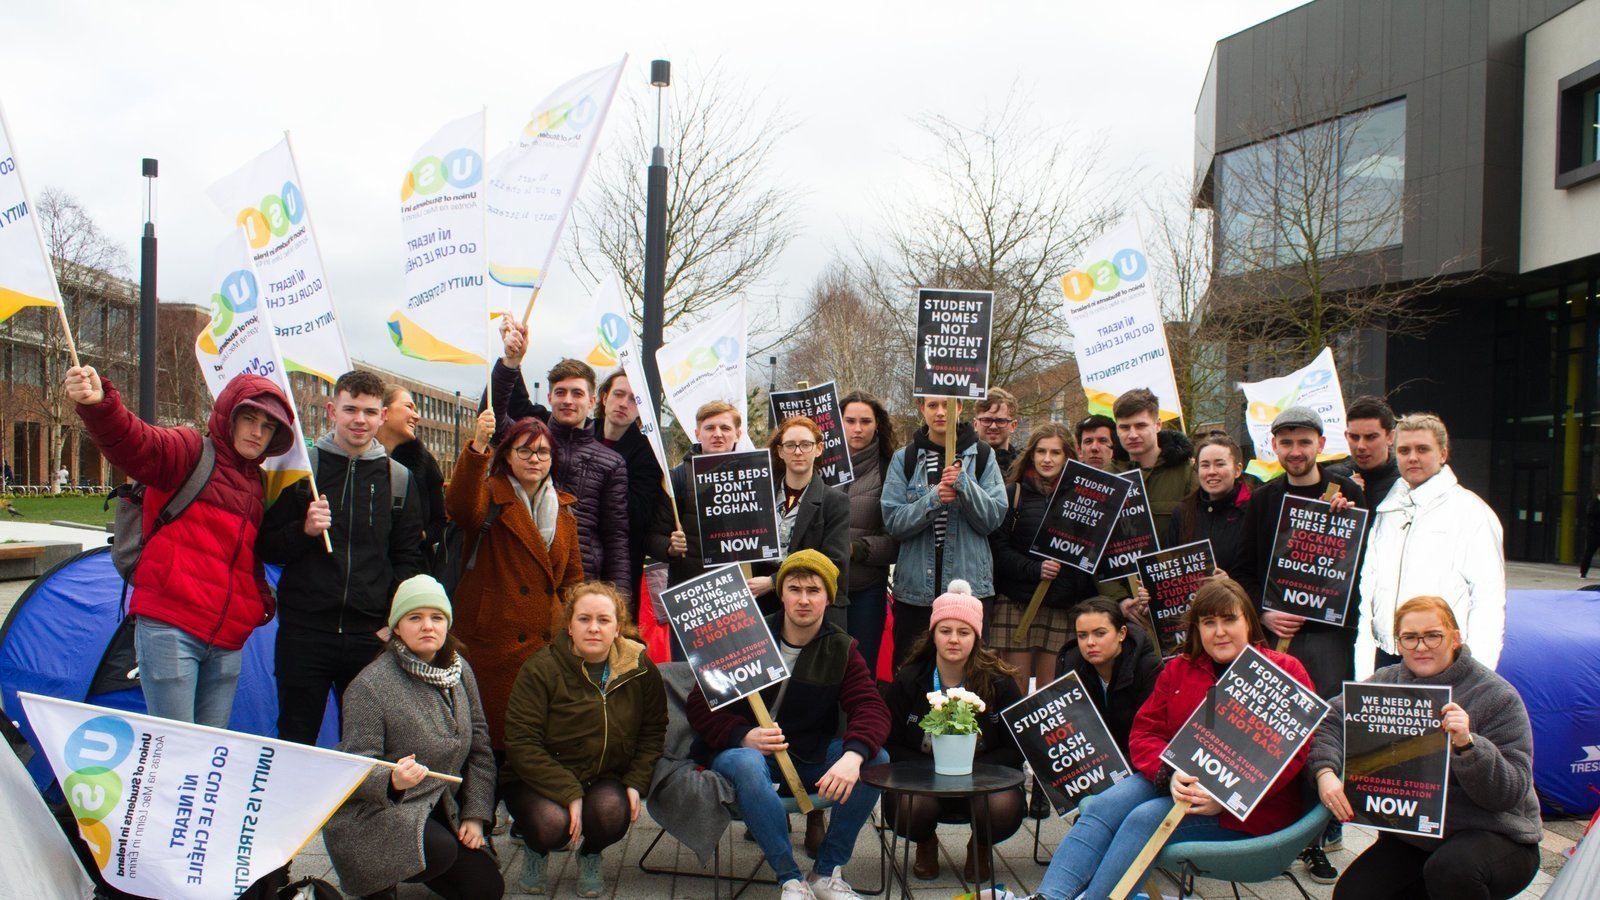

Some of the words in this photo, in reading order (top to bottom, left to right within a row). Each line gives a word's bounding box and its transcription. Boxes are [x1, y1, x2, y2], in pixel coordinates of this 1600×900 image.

[924, 299, 984, 312] STUDENT
[931, 311, 978, 323] HOMES
[941, 324, 969, 335] NOT
[924, 335, 983, 348] STUDENT
[928, 347, 978, 359] HOTELS
[932, 373, 970, 387] NOW
[779, 399, 811, 410] RENTS
[814, 393, 832, 406] LIKE
[782, 409, 813, 419] THESE
[816, 404, 833, 416] ARE
[697, 470, 734, 484] THESE
[738, 468, 769, 480] BEDS
[1073, 476, 1115, 496] STUDENT
[714, 480, 753, 493] DON'T
[713, 491, 757, 504] COUNT
[1077, 495, 1097, 508] NOT
[705, 502, 763, 517] EOGHAN.
[1062, 509, 1097, 527] HOTELS
[1063, 500, 1104, 520] STUDENT
[1289, 507, 1327, 523] RENTS
[1330, 516, 1357, 530] LIKE
[709, 529, 750, 539] AFFORDABLE
[1290, 518, 1326, 534] THESE
[1328, 526, 1352, 539] ARE
[1291, 529, 1346, 548] LOCKING
[720, 537, 759, 553] NOW
[1050, 537, 1085, 556] NOW
[1287, 539, 1346, 559] STUDENTS
[1108, 550, 1142, 569] NOW
[1146, 558, 1180, 574] RENTS
[1182, 552, 1206, 565] LIKE
[1291, 550, 1315, 564] OUT
[1318, 556, 1334, 567] OF
[1150, 568, 1182, 582] THESE
[1186, 561, 1206, 574] ARE
[1277, 558, 1346, 580] EDUCATION
[674, 581, 713, 603] PEOPLE
[715, 573, 734, 588] ARE
[1156, 571, 1205, 590] LOCKING
[1156, 580, 1200, 600] STUDEN
[1277, 578, 1319, 593] AFFORDABLE
[673, 603, 712, 625] YOUNG
[714, 588, 750, 607] PEOPLE
[690, 587, 727, 607] DYING.
[1164, 595, 1185, 608] OUT
[1189, 593, 1197, 603] O
[1284, 589, 1327, 609] NOW
[684, 617, 704, 633] ARE
[705, 600, 748, 621] LEAVING
[1157, 604, 1192, 620] EDUCA
[692, 638, 704, 649] IS
[705, 628, 729, 644] NOT
[730, 616, 757, 633] BACK
[693, 624, 713, 637] THE
[717, 610, 747, 628] BOOM
[698, 650, 741, 673] AFFORDABLE
[742, 639, 769, 655] STUDENT
[724, 660, 763, 689] NOW
[1249, 660, 1291, 695] PEOPLE
[1290, 692, 1315, 713] ARE
[1254, 680, 1291, 712] DYING.
[1014, 688, 1083, 734] STUDENTS
[1228, 670, 1269, 705] YOUNG
[1267, 701, 1309, 738] PEOPLE
[1360, 705, 1433, 718] AFFORDABLE
[1362, 695, 1379, 705] WE
[1382, 697, 1411, 707] NEED
[1415, 699, 1432, 709] AN
[1224, 684, 1249, 705] ARE
[1247, 702, 1296, 741] LEAVING
[1226, 698, 1247, 720] THE
[1248, 715, 1283, 745] BOOM
[1344, 713, 1441, 728] ACCOMMODATIO
[1040, 713, 1066, 736] ARE
[1044, 722, 1076, 746] NOT
[1215, 702, 1225, 716] IS
[1227, 713, 1253, 735] NOT
[1252, 732, 1285, 760] BACK
[1368, 724, 1426, 737] STRATEGY
[1048, 732, 1087, 759] CASH
[1192, 721, 1236, 757] AFFORDABLE
[1236, 756, 1269, 782] STUDENT
[1052, 743, 1096, 773] COWS
[1191, 747, 1241, 789] NOW
[1193, 734, 1257, 784] ACCOMMODATION
[1570, 762, 1600, 774] TRES
[1051, 763, 1091, 788] AFFORDABLE
[1064, 765, 1105, 798] NOW
[1349, 774, 1401, 787] AFFORDABLE
[1403, 780, 1441, 791] STUDENT
[1356, 784, 1432, 799] ACCOMMODATION
[1366, 795, 1418, 817] NOW
